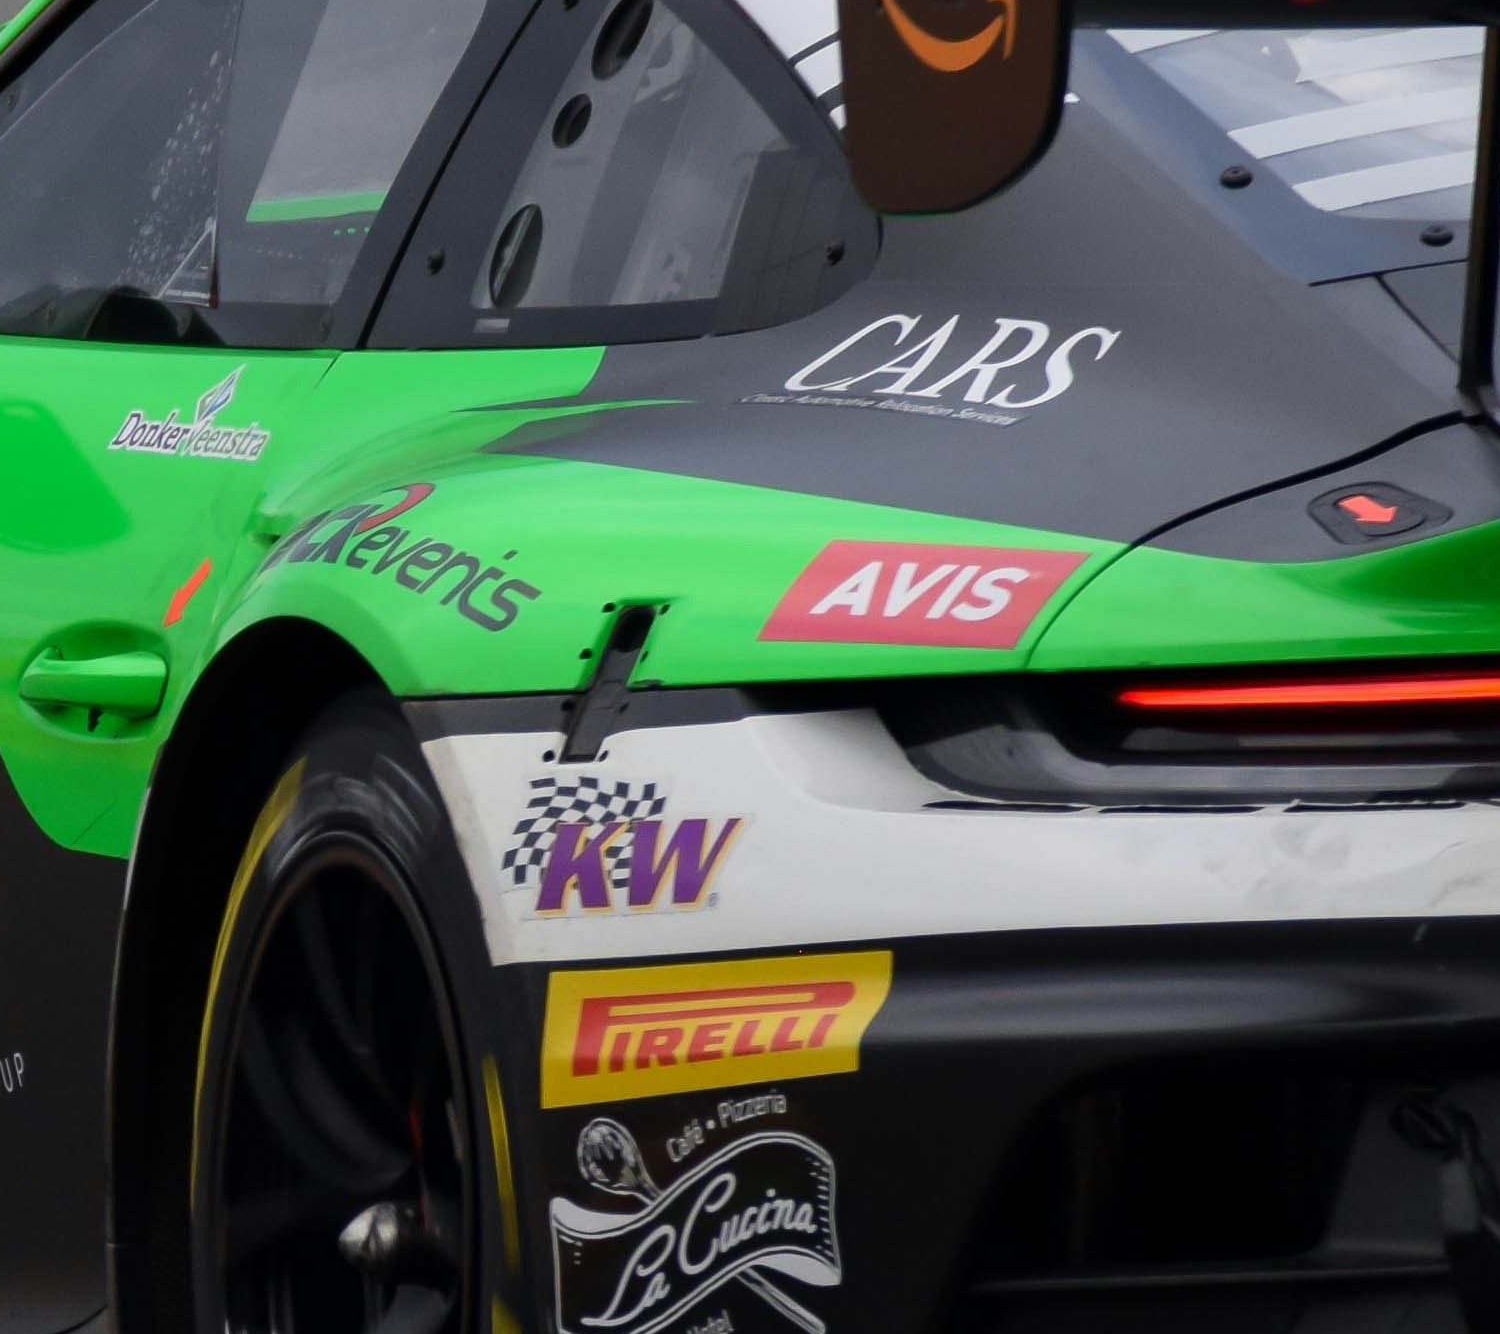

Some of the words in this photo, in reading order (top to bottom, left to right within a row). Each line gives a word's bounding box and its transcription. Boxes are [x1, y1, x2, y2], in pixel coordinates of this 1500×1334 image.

[784, 314, 1122, 409] CARS
[808, 559, 1029, 622] AVIS
[535, 816, 744, 917] KW
[571, 980, 857, 1078] PIRELLI
[716, 1088, 788, 1129] Pizzeria
[580, 1224, 676, 1327] La
[677, 1171, 818, 1275] Cucina
